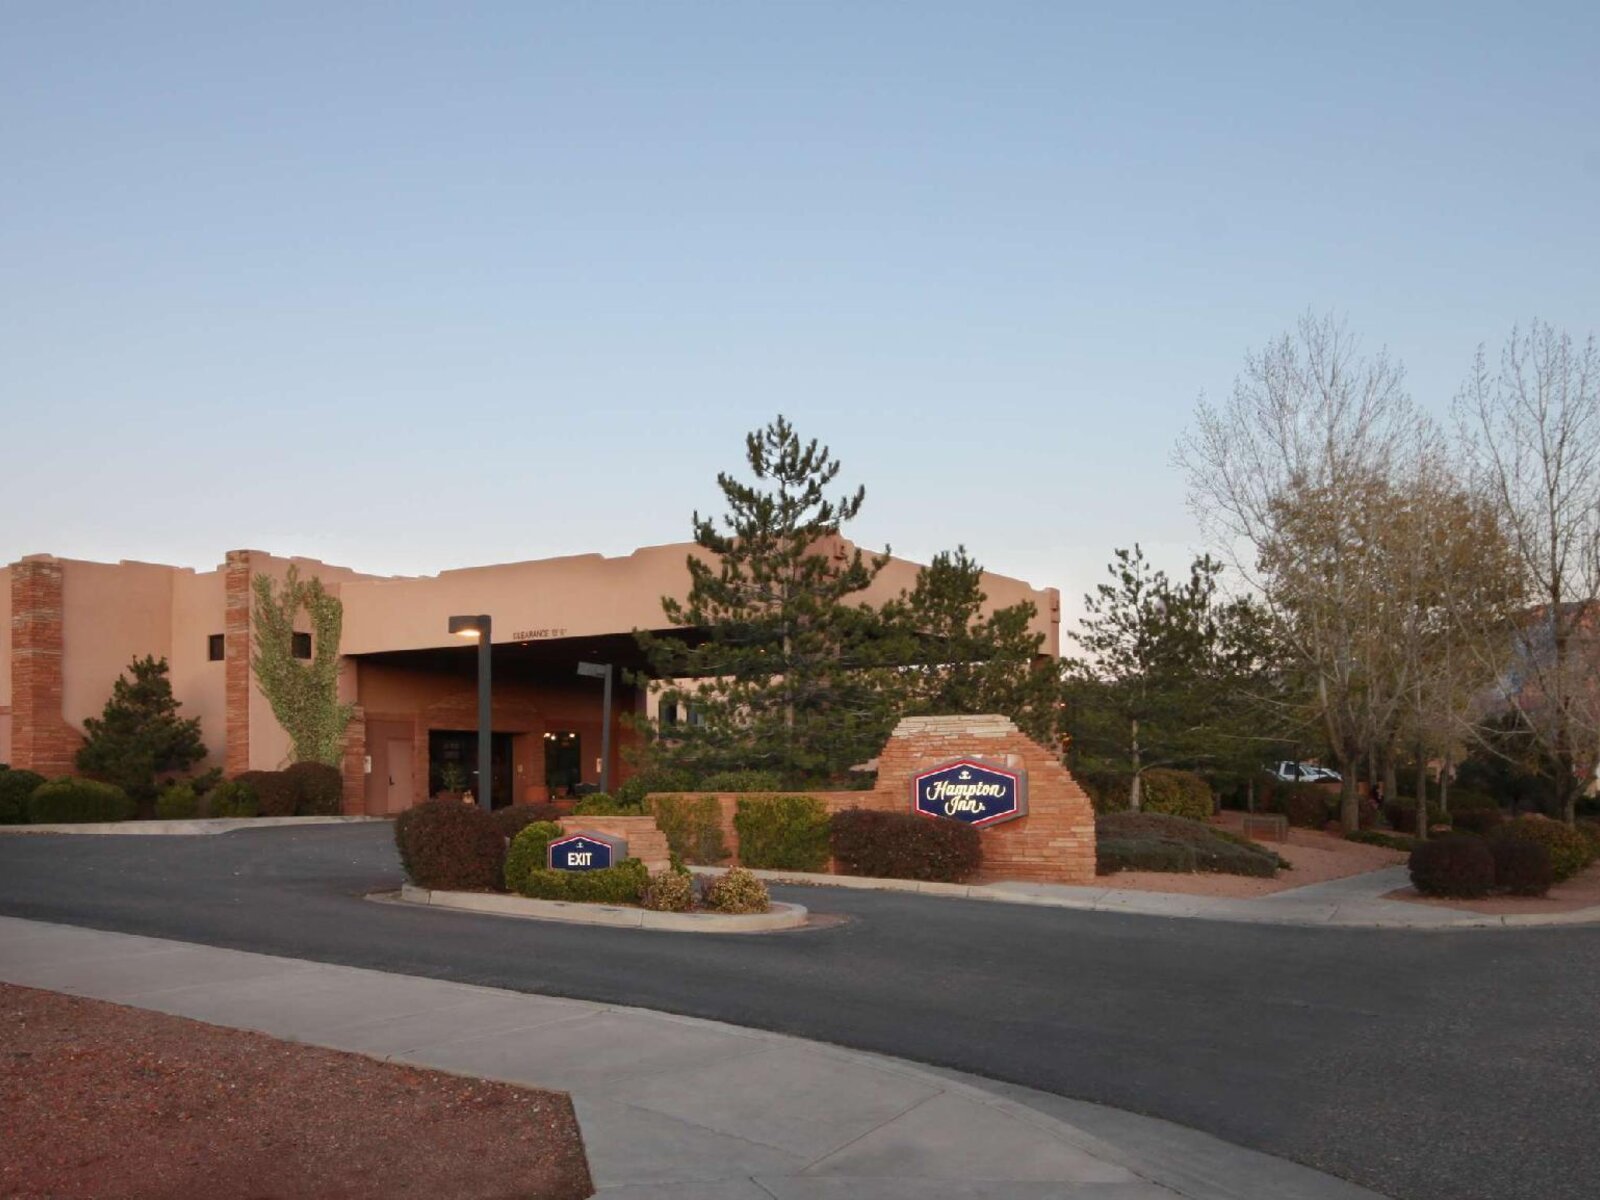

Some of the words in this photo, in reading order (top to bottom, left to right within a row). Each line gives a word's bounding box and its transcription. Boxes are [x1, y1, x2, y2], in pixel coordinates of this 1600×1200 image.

[513, 629, 549, 640] CLEARANCE
[926, 780, 1006, 801] Hampton
[945, 795, 983, 815] Inn
[567, 852, 593, 866] EXIT
